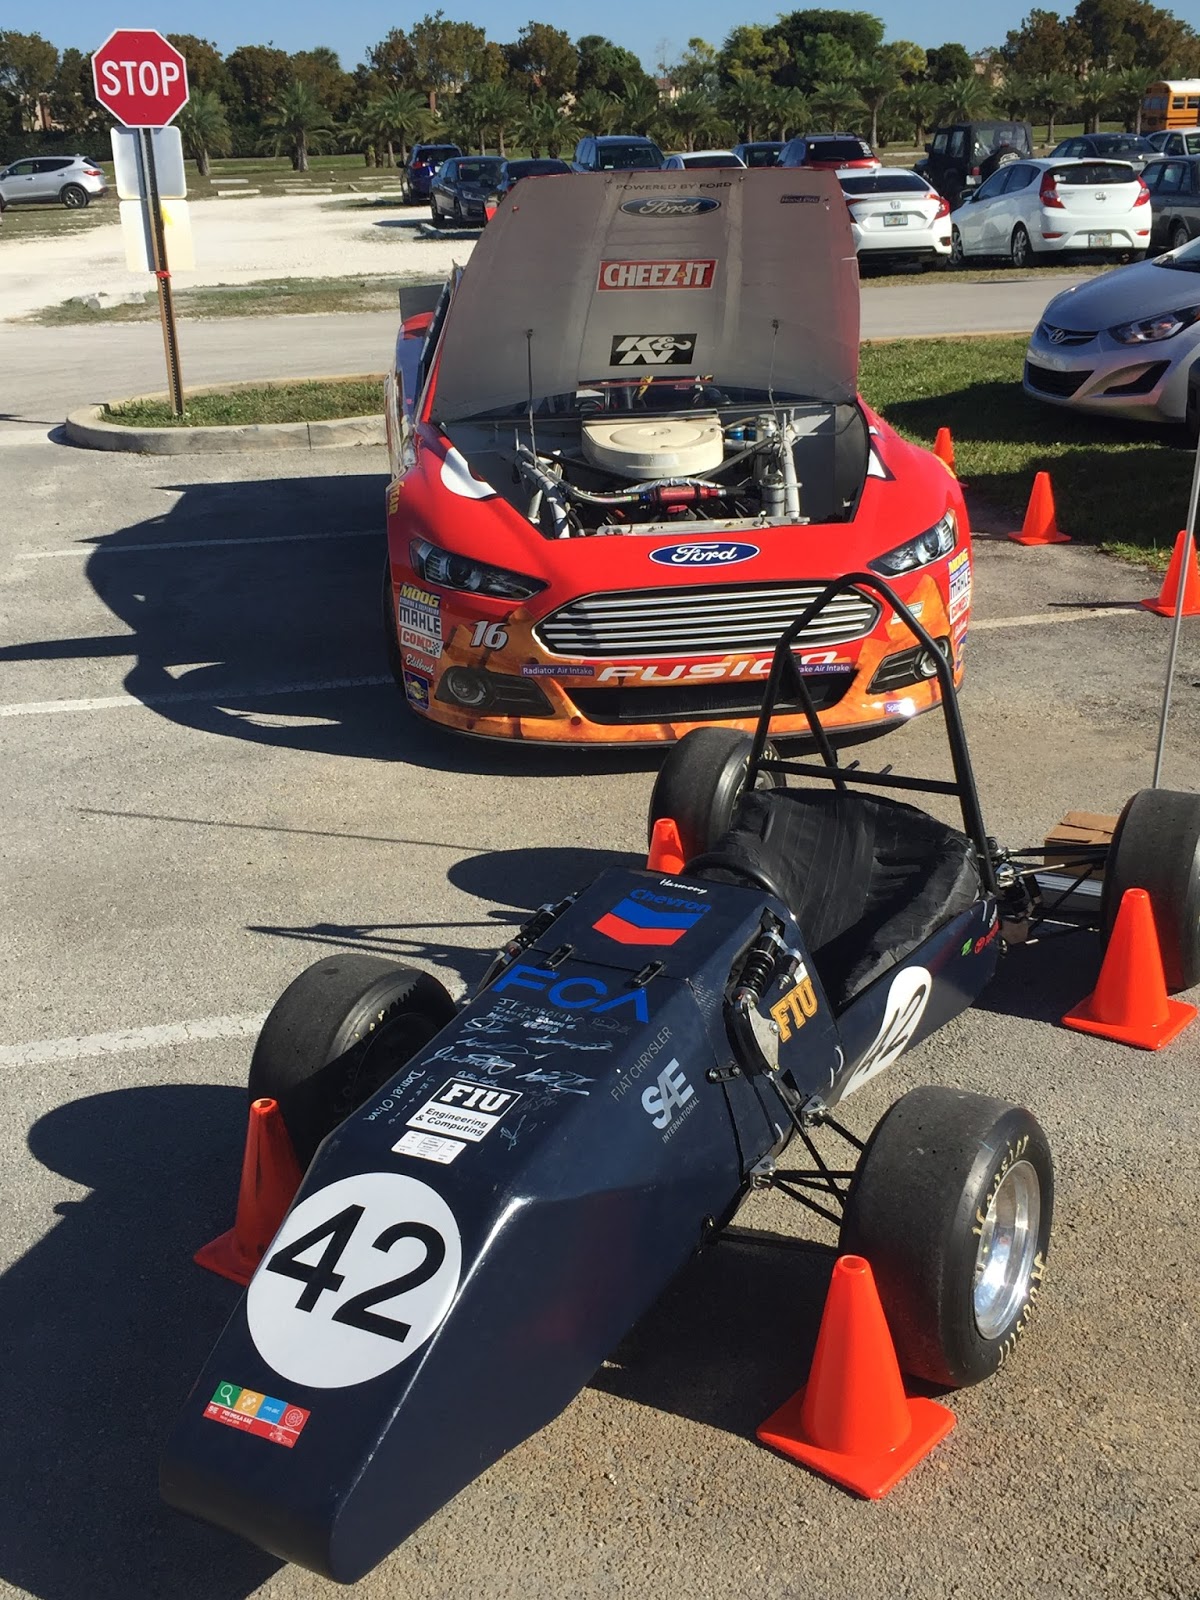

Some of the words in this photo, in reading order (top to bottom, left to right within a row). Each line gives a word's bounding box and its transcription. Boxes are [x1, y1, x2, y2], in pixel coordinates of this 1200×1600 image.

[102, 60, 179, 96] STOP
[616, 183, 677, 191] POWERED
[700, 181, 732, 189] FORD
[638, 198, 700, 215] Ford
[615, 336, 692, 364] K&N
[671, 541, 738, 564] Ford
[400, 585, 440, 608] MOOG
[400, 607, 441, 635] MAHLE
[403, 630, 432, 648] COMP
[470, 621, 508, 650] 16
[523, 667, 555, 675] Radiator
[814, 665, 825, 673] Air
[826, 664, 850, 672] Intake
[630, 888, 711, 912] Chevron
[660, 879, 707, 894] Harmony
[491, 964, 649, 1023] FCA
[769, 976, 818, 1043] FIU
[854, 984, 926, 1076] 42
[610, 1074, 633, 1101] FIAT
[629, 1026, 673, 1079] CHRYSLER
[390, 1069, 426, 1100] Daniel
[440, 1083, 511, 1112] FIU
[641, 1058, 695, 1129] SAE
[363, 1098, 394, 1121] Oliva
[425, 1108, 488, 1129] Engineering
[662, 1097, 700, 1143] INTERNATIONAL
[427, 1117, 484, 1137] Computing
[265, 1203, 446, 1343] 42
